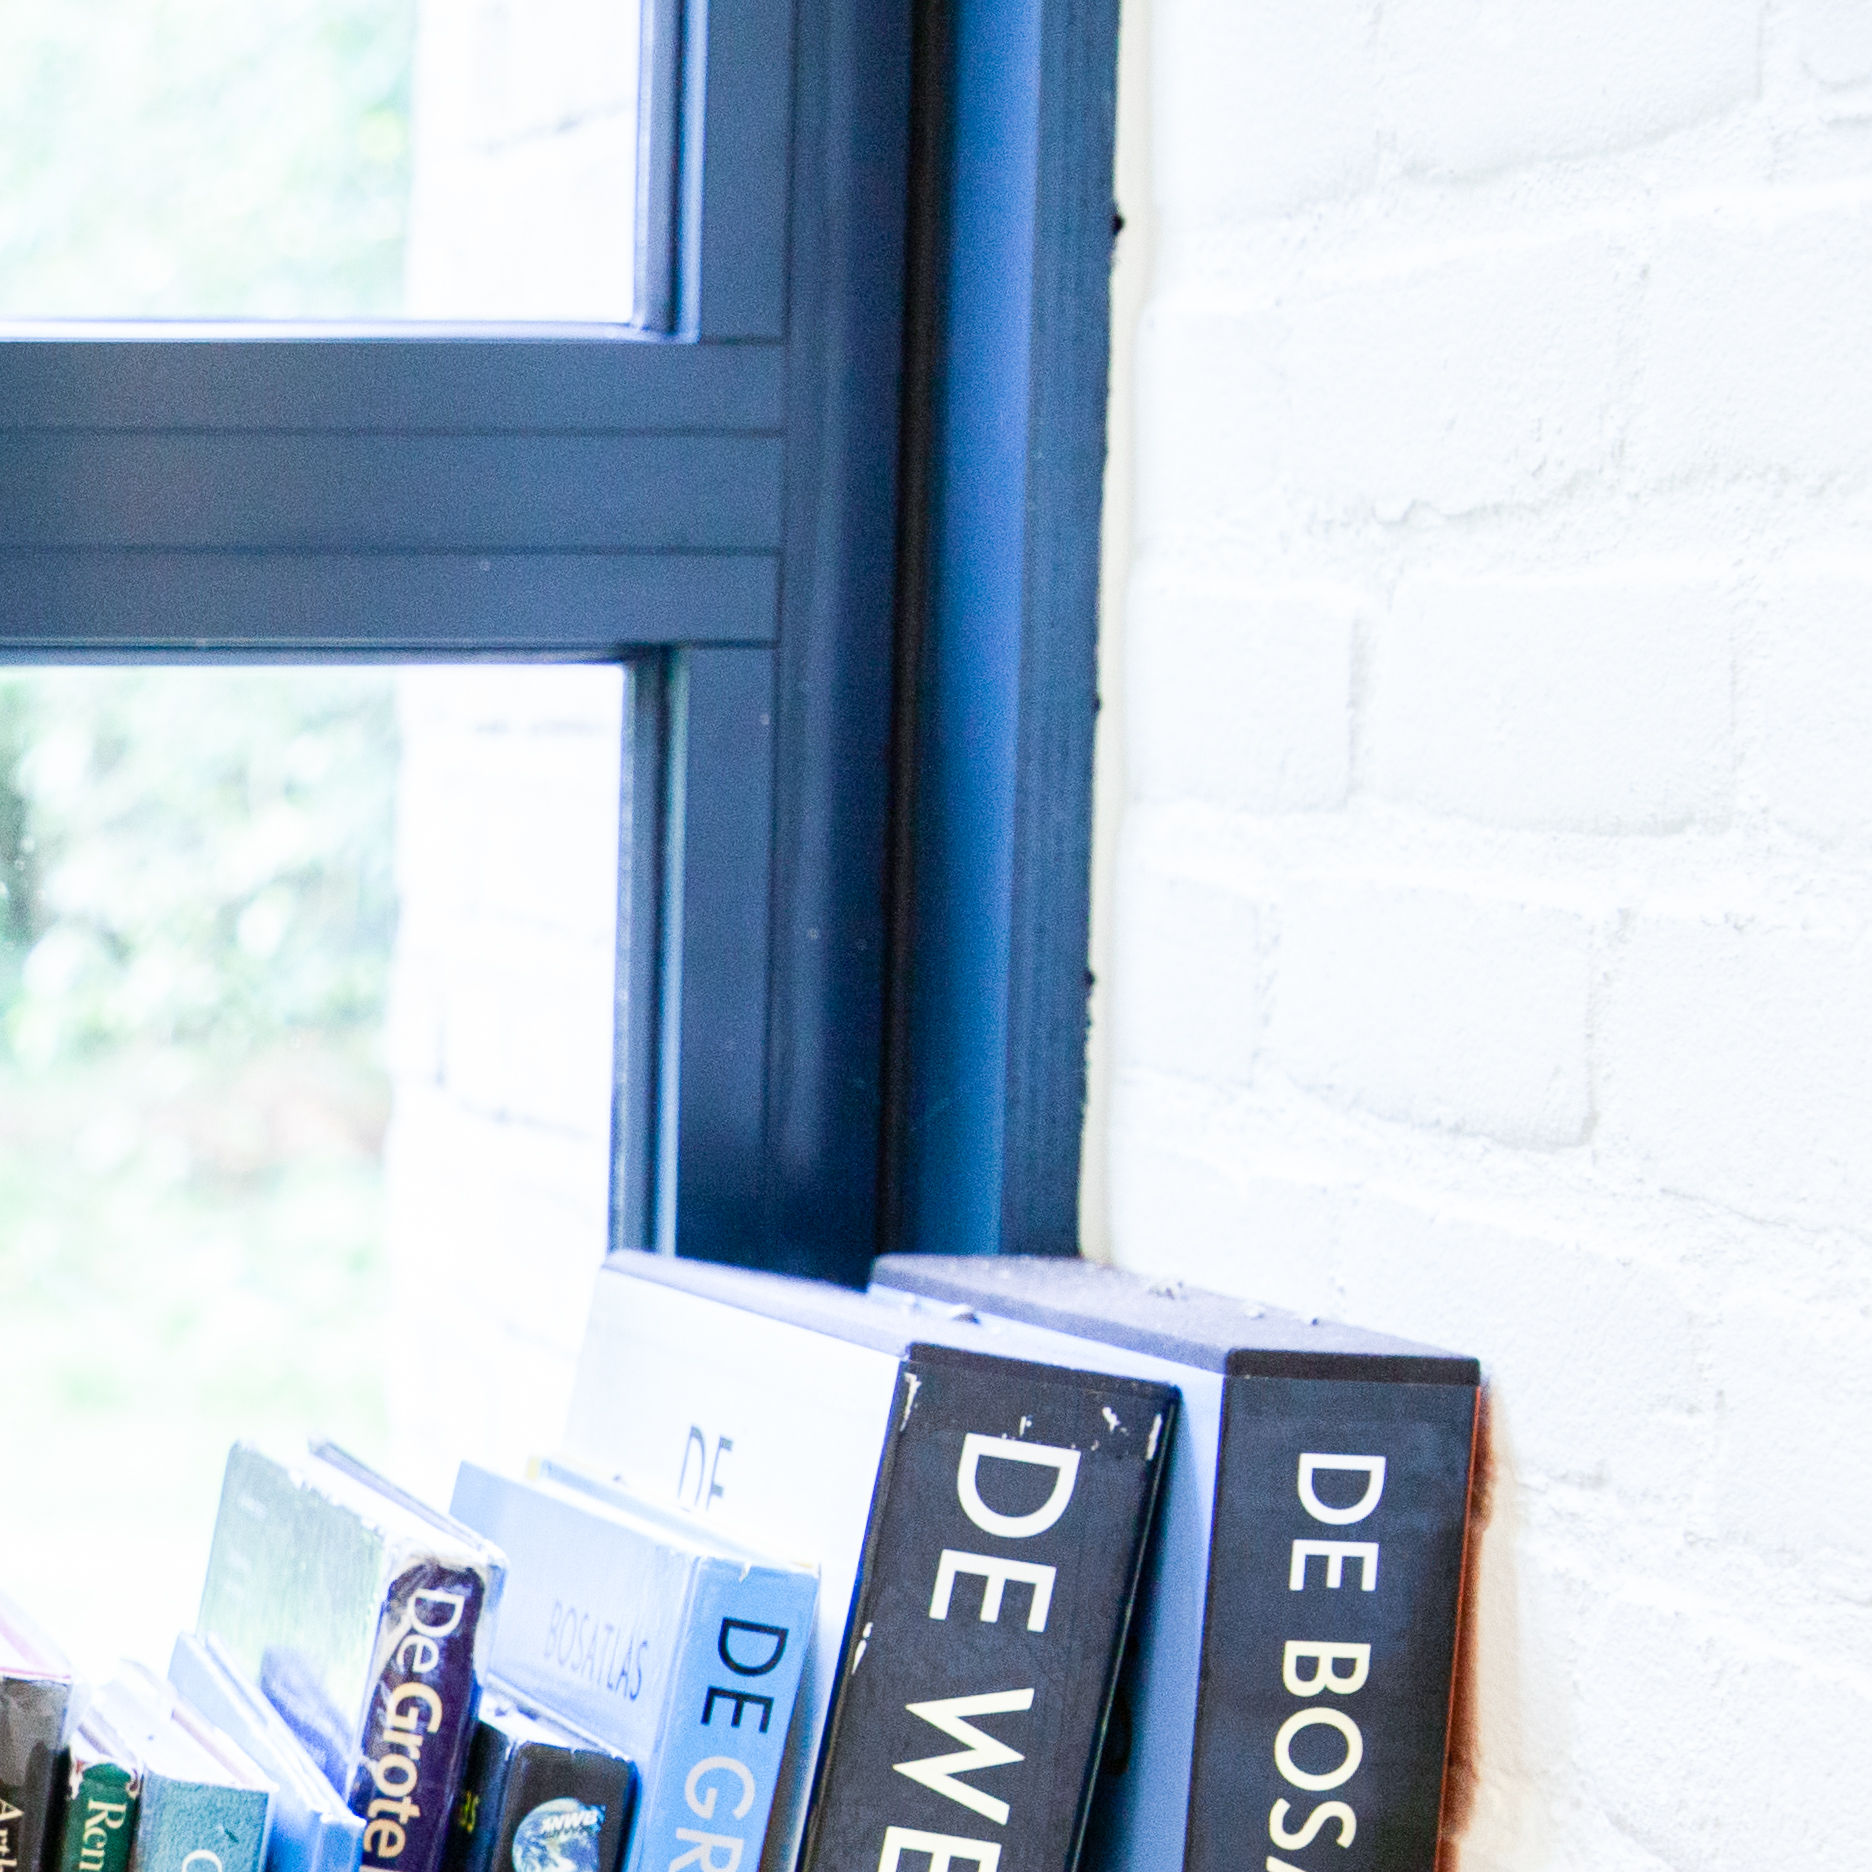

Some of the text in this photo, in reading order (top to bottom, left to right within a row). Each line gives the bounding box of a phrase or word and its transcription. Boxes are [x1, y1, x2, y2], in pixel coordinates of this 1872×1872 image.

[928, 1432, 1082, 1634] DE
[1289, 1451, 1387, 1592] DE
[396, 1590, 466, 1675] De
[543, 1599, 648, 1701] BOSATLAS
[700, 1616, 791, 1735] DE
[363, 1681, 443, 1858] Grote
